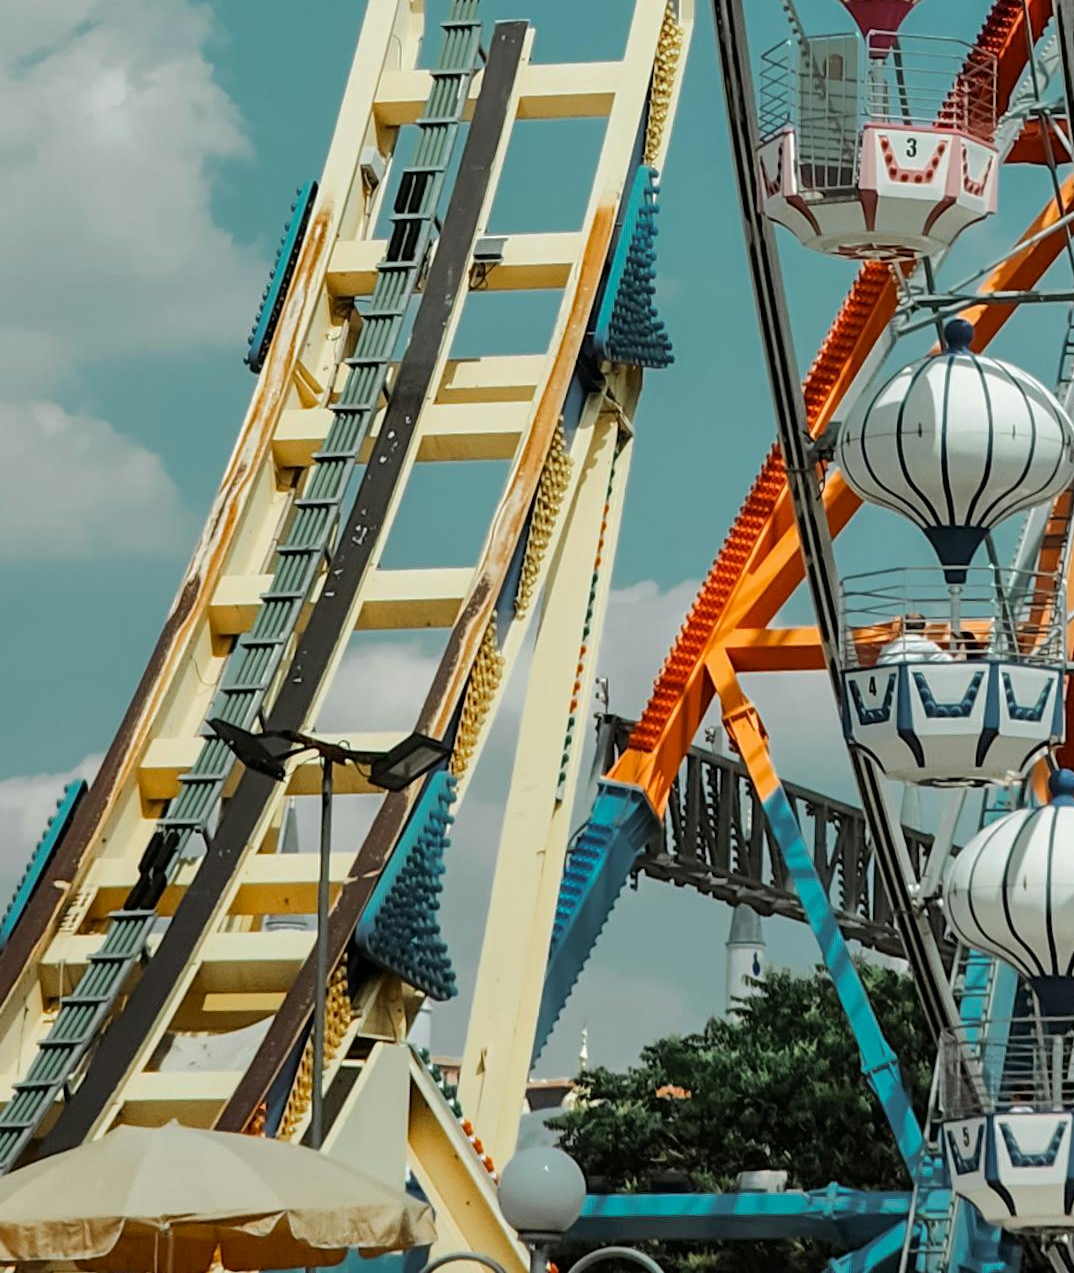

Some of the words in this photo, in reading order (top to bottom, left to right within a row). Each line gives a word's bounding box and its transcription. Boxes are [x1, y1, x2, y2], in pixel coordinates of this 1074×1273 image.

[906, 137, 917, 158] 3
[869, 675, 877, 696] 4
[962, 1126, 970, 1147] 5
